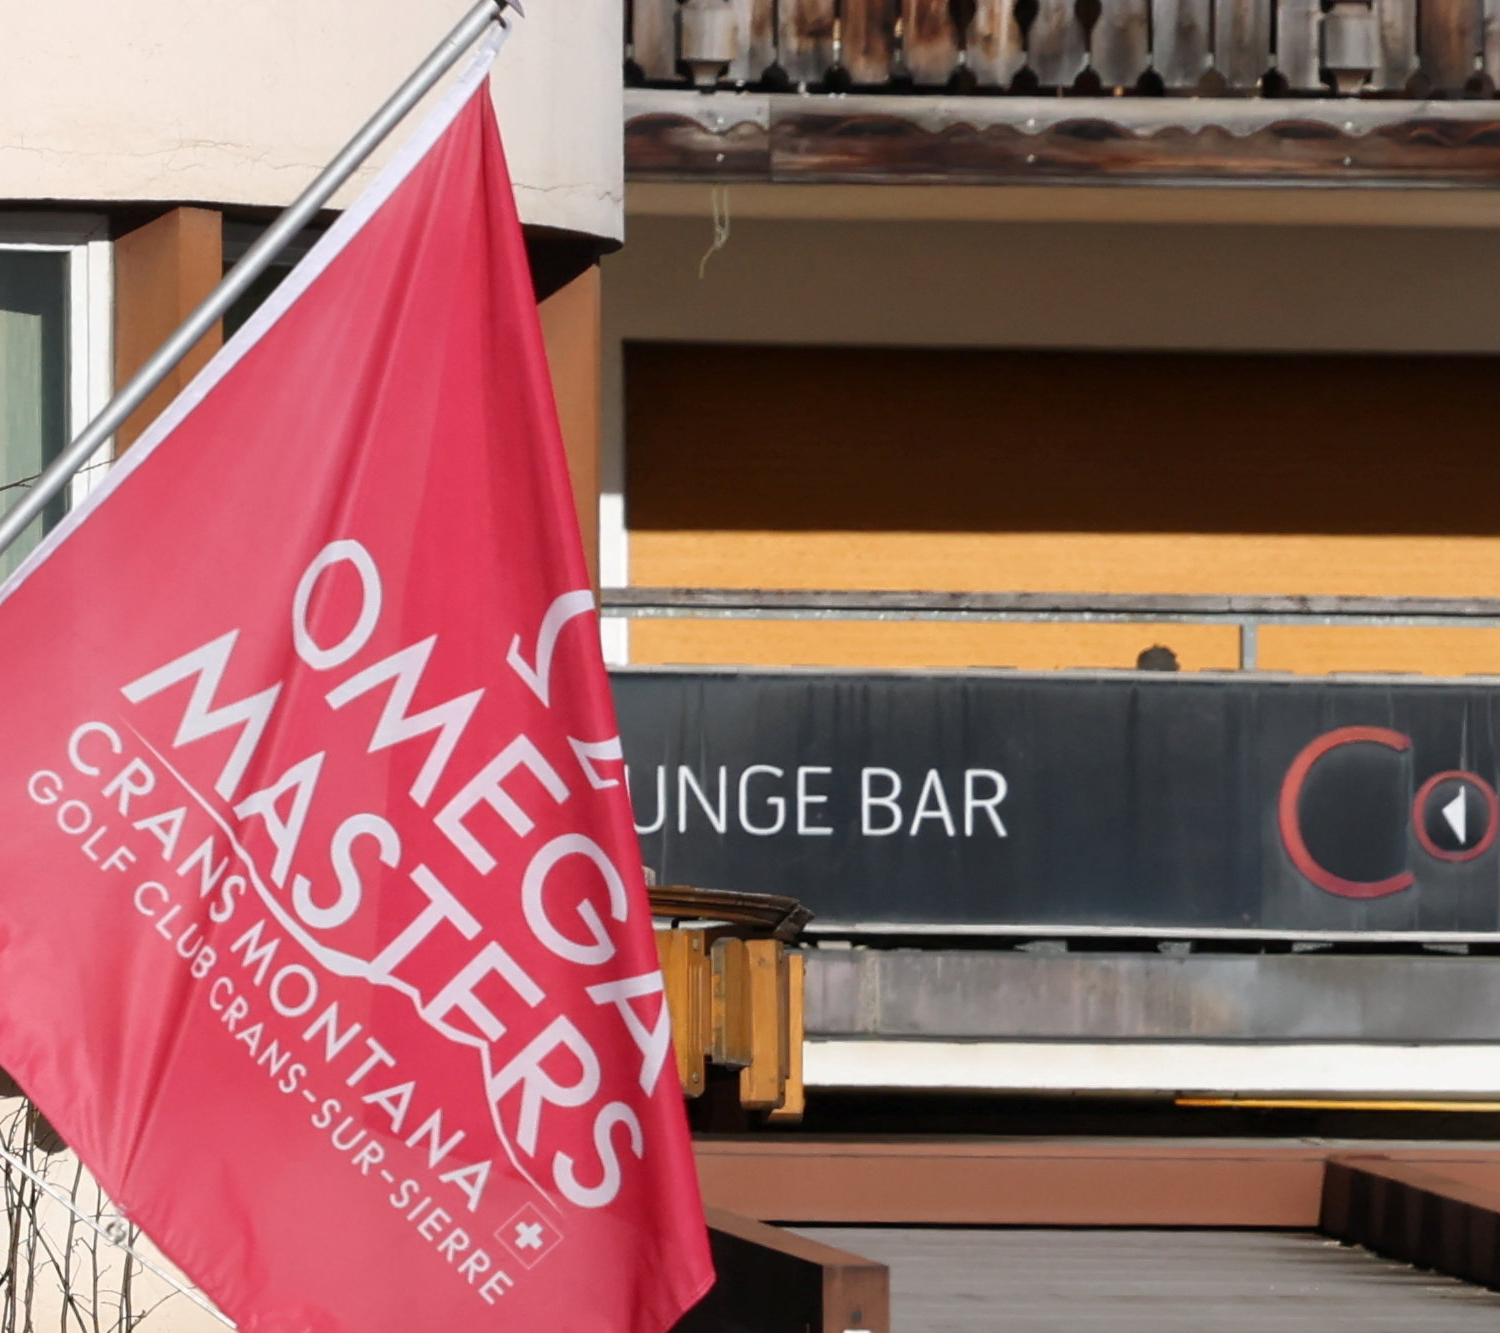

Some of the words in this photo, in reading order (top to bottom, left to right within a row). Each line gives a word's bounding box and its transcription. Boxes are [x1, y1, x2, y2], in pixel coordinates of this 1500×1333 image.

[27, 769, 138, 872] GOLF
[133, 881, 218, 979] CLUB
[209, 976, 515, 1305] CRANS-SUR-SIERRE
[68, 721, 247, 923] CRANS
[230, 919, 493, 1213] MONTANA
[120, 628, 644, 1208] MASTERS
[293, 539, 672, 1096] OMEGA
[624, 764, 832, 838] UNGE
[859, 765, 1010, 838] BAR
